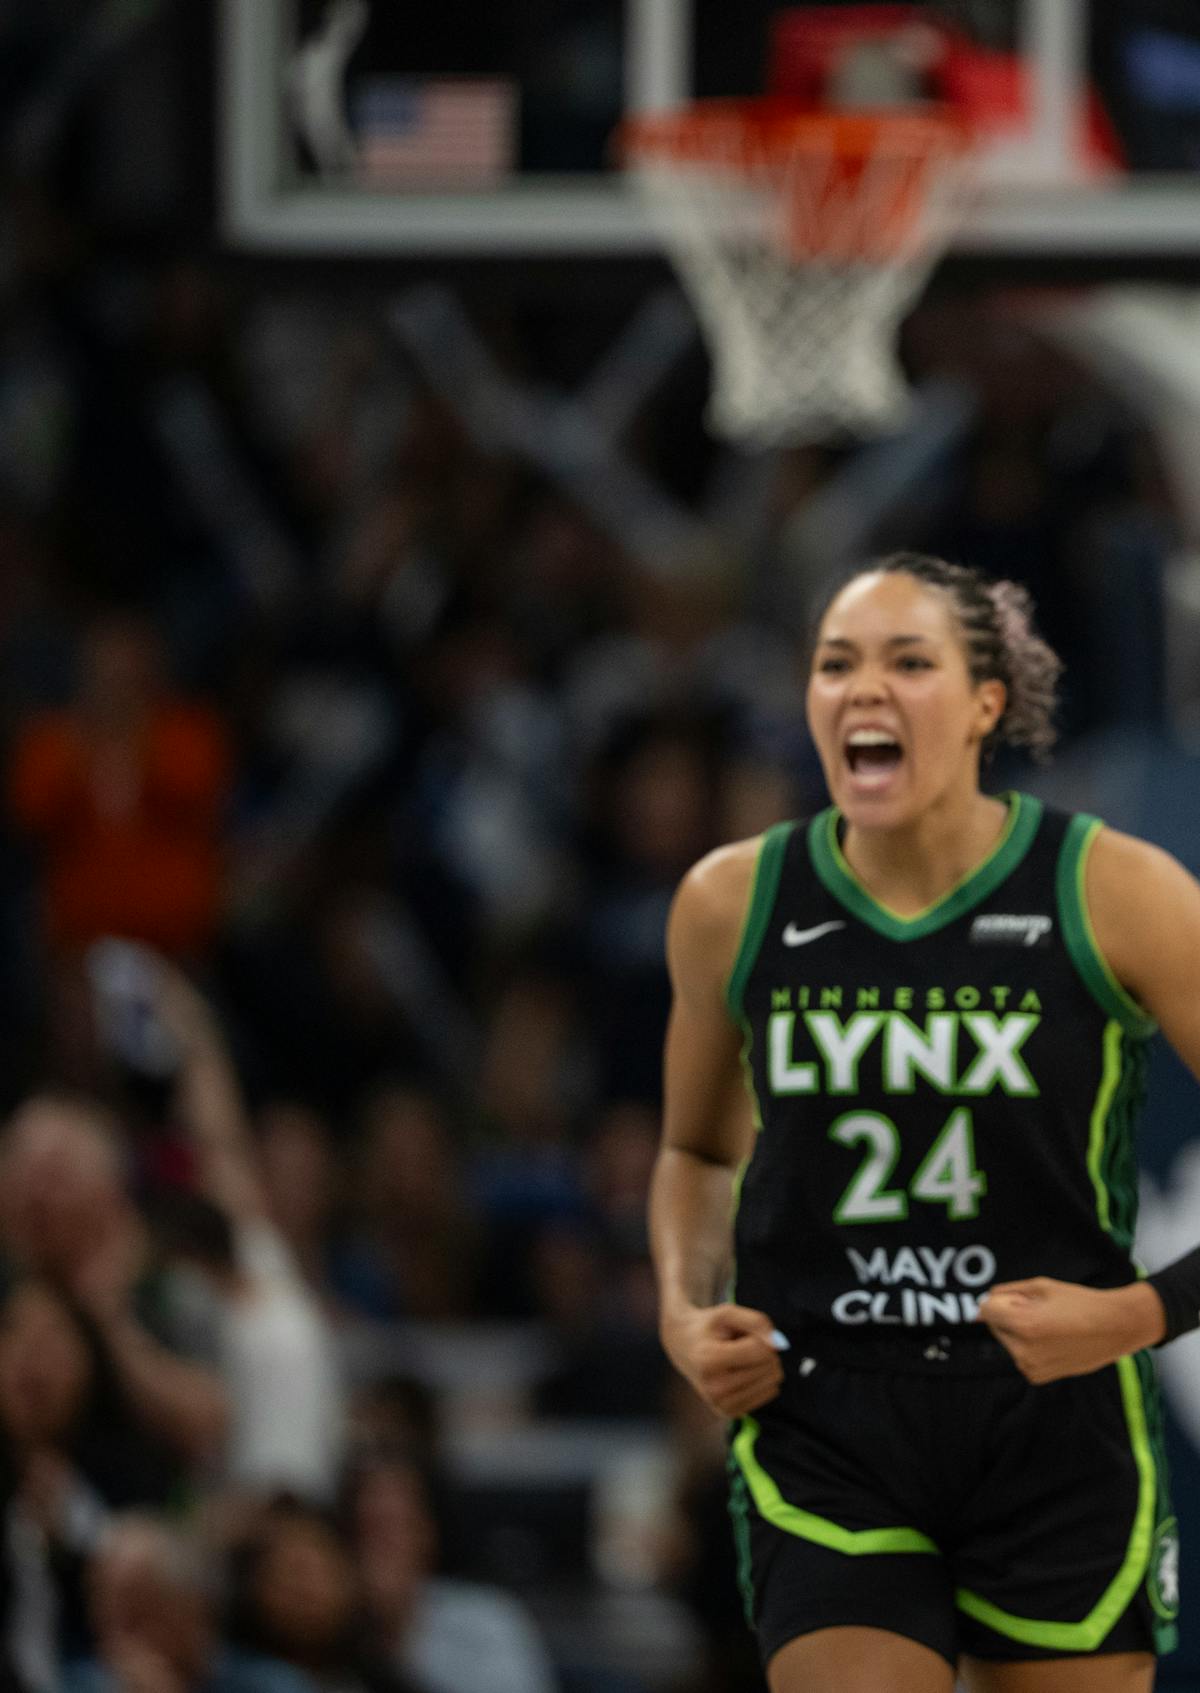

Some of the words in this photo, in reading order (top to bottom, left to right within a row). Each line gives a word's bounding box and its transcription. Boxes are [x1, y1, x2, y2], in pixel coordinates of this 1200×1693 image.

[770, 985, 1042, 1011] MINNESOTA
[766, 1009, 1042, 1098] LYNX
[827, 1105, 988, 1226] 24
[846, 1245, 997, 1289] MAYO
[831, 1287, 991, 1327] CLINI
